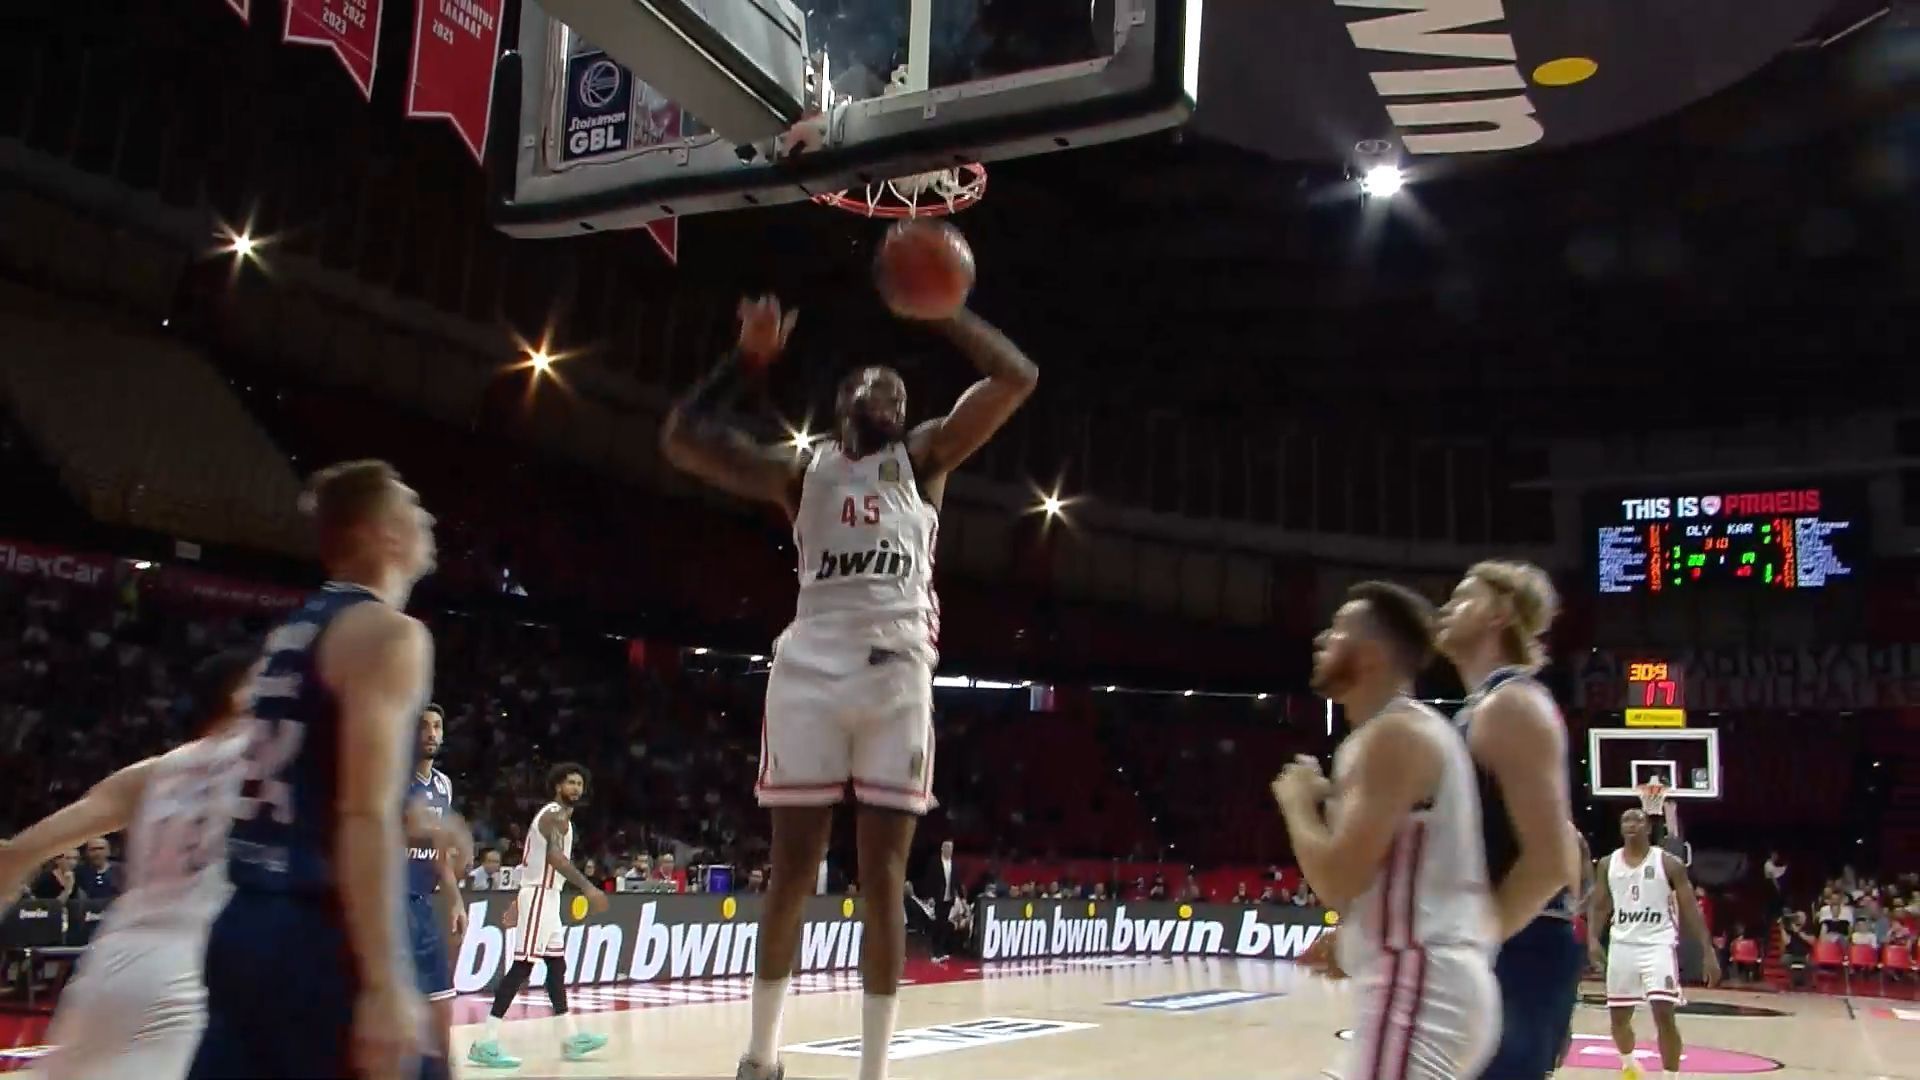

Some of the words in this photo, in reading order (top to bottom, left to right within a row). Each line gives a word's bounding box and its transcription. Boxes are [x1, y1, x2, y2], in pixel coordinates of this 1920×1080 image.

[570, 125, 622, 154] GBL
[841, 495, 880, 527] 45
[1621, 497, 1671, 521] THIS
[1677, 495, 1699, 518] IS
[1685, 524, 1712, 537] OLY
[1726, 522, 1754, 535] KAR
[815, 540, 912, 580] bwin
[1645, 681, 1676, 706] 17
[502, 869, 511, 886] 3
[1631, 885, 1640, 901] 9
[1617, 907, 1662, 925] bwin
[629, 895, 757, 982] bwin
[983, 902, 1046, 960] bwin
[1051, 902, 1107, 956] bwin
[1111, 903, 1224, 954] bwin
